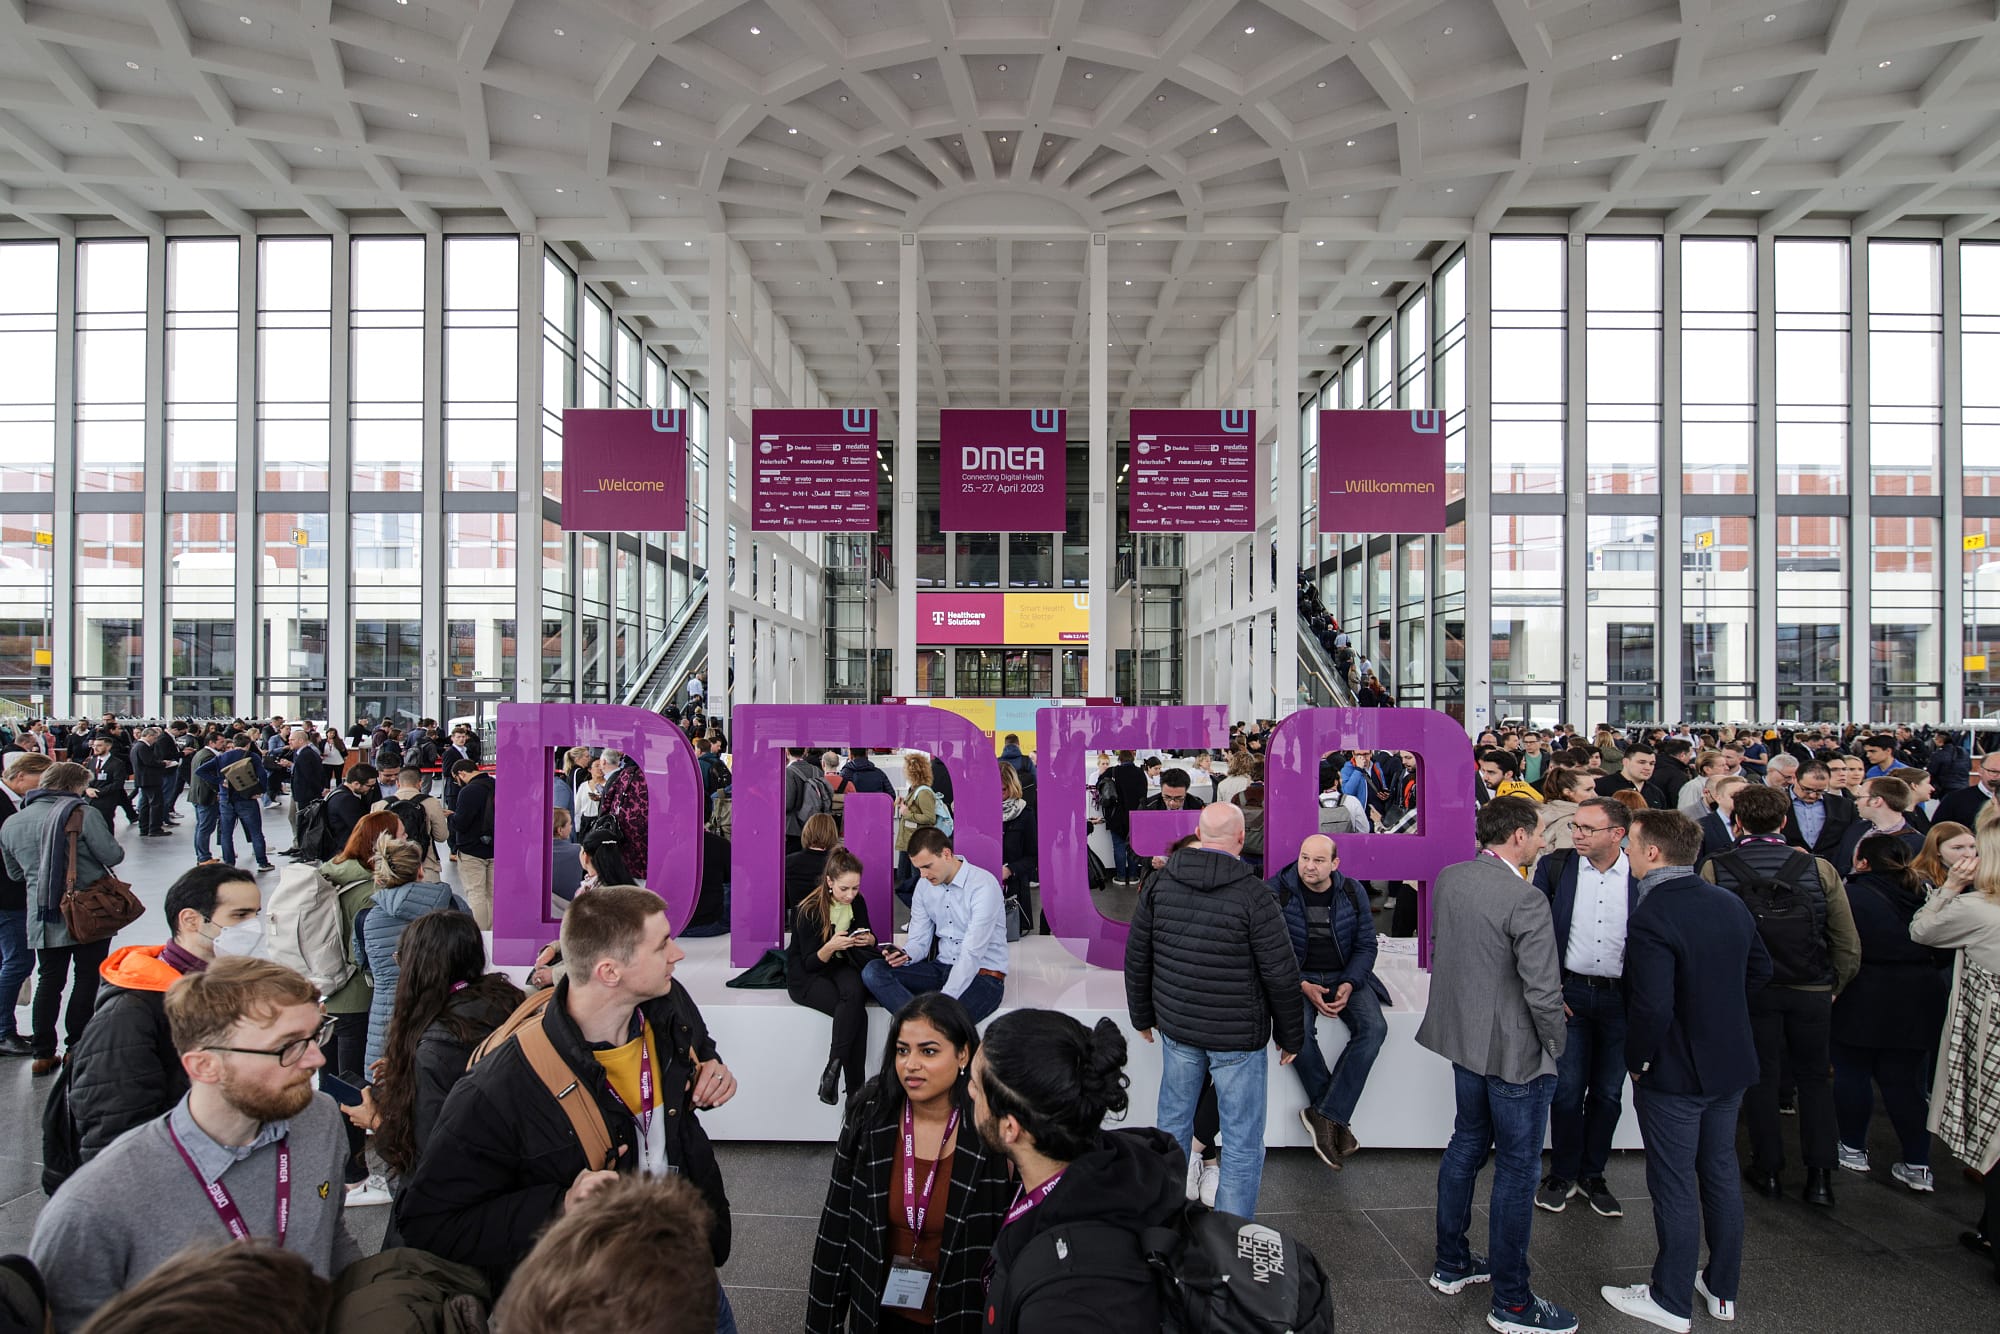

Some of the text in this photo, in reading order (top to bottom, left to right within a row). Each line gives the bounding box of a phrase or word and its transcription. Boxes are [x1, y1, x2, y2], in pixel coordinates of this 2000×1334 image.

[962, 446, 1045, 470] DMEA
[962, 474, 1000, 482] Connecting
[1001, 474, 1022, 482] Digital
[997, 483, 1018, 495] April
[1020, 483, 1044, 493] 2023
[947, 611, 986, 619] Healthcare
[492, 702, 1475, 970] DMEA
[280, 1153, 289, 1183] DMEA
[1237, 1235, 1253, 1259] THE
[1267, 1240, 1285, 1276] FACE
[1252, 1239, 1270, 1283] NORTH
